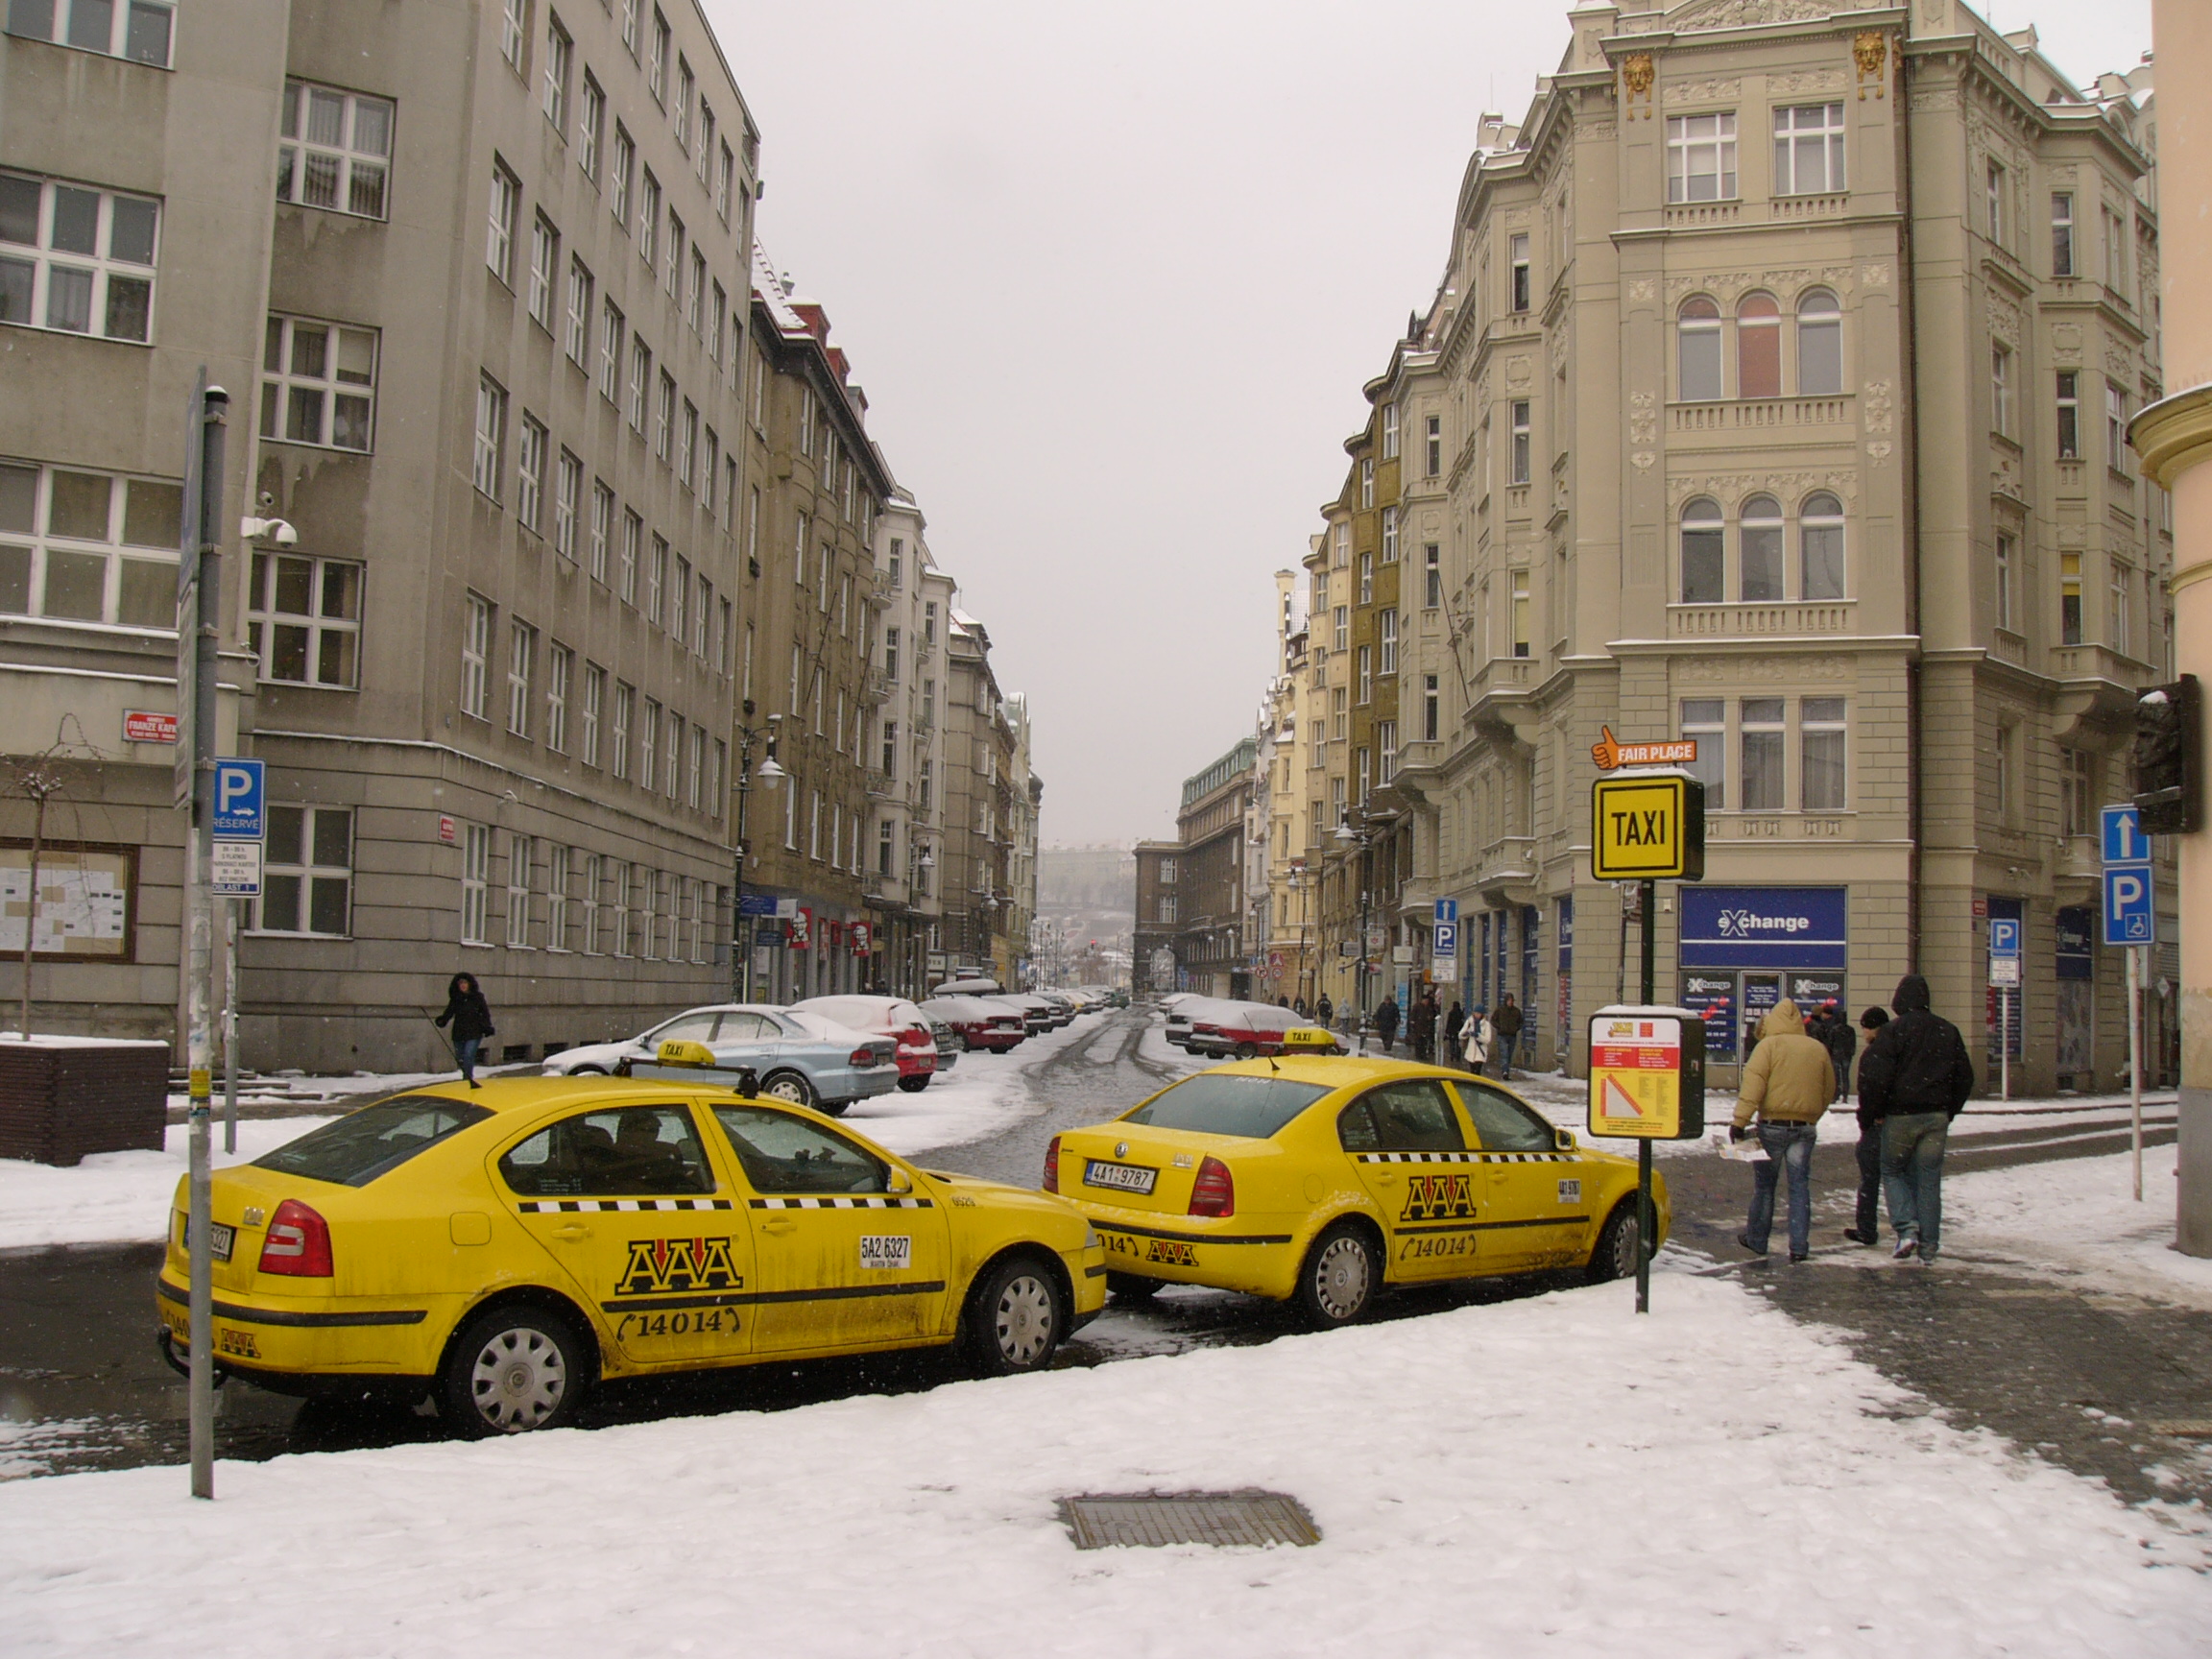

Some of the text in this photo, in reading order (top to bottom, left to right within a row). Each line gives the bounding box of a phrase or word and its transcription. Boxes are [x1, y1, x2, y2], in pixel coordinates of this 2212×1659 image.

[129, 720, 177, 733] FRANZE KAFK
[1618, 744, 1693, 761] FAIR PLACE
[220, 768, 252, 812] P
[213, 817, 259, 830] RÉSERVÉ
[1611, 809, 1666, 846] TAXI
[2113, 876, 2144, 921] P
[1718, 910, 1810, 936] eXchange
[1438, 926, 1453, 947] P
[1996, 925, 2013, 947] P
[1688, 978, 1731, 993] eXchange
[1794, 979, 1839, 994] eXchange
[1292, 1032, 1311, 1042] TAXI
[664, 1044, 684, 1056] TAXI
[1094, 1165, 1149, 1187] 4A1 9787
[1400, 1174, 1477, 1222] AAA
[861, 1238, 909, 1259] 5A2 6327
[1146, 1239, 1199, 1266] AAA
[1413, 1237, 1466, 1258] 14014
[614, 1237, 744, 1296] AAA
[637, 1310, 722, 1336] 14014
